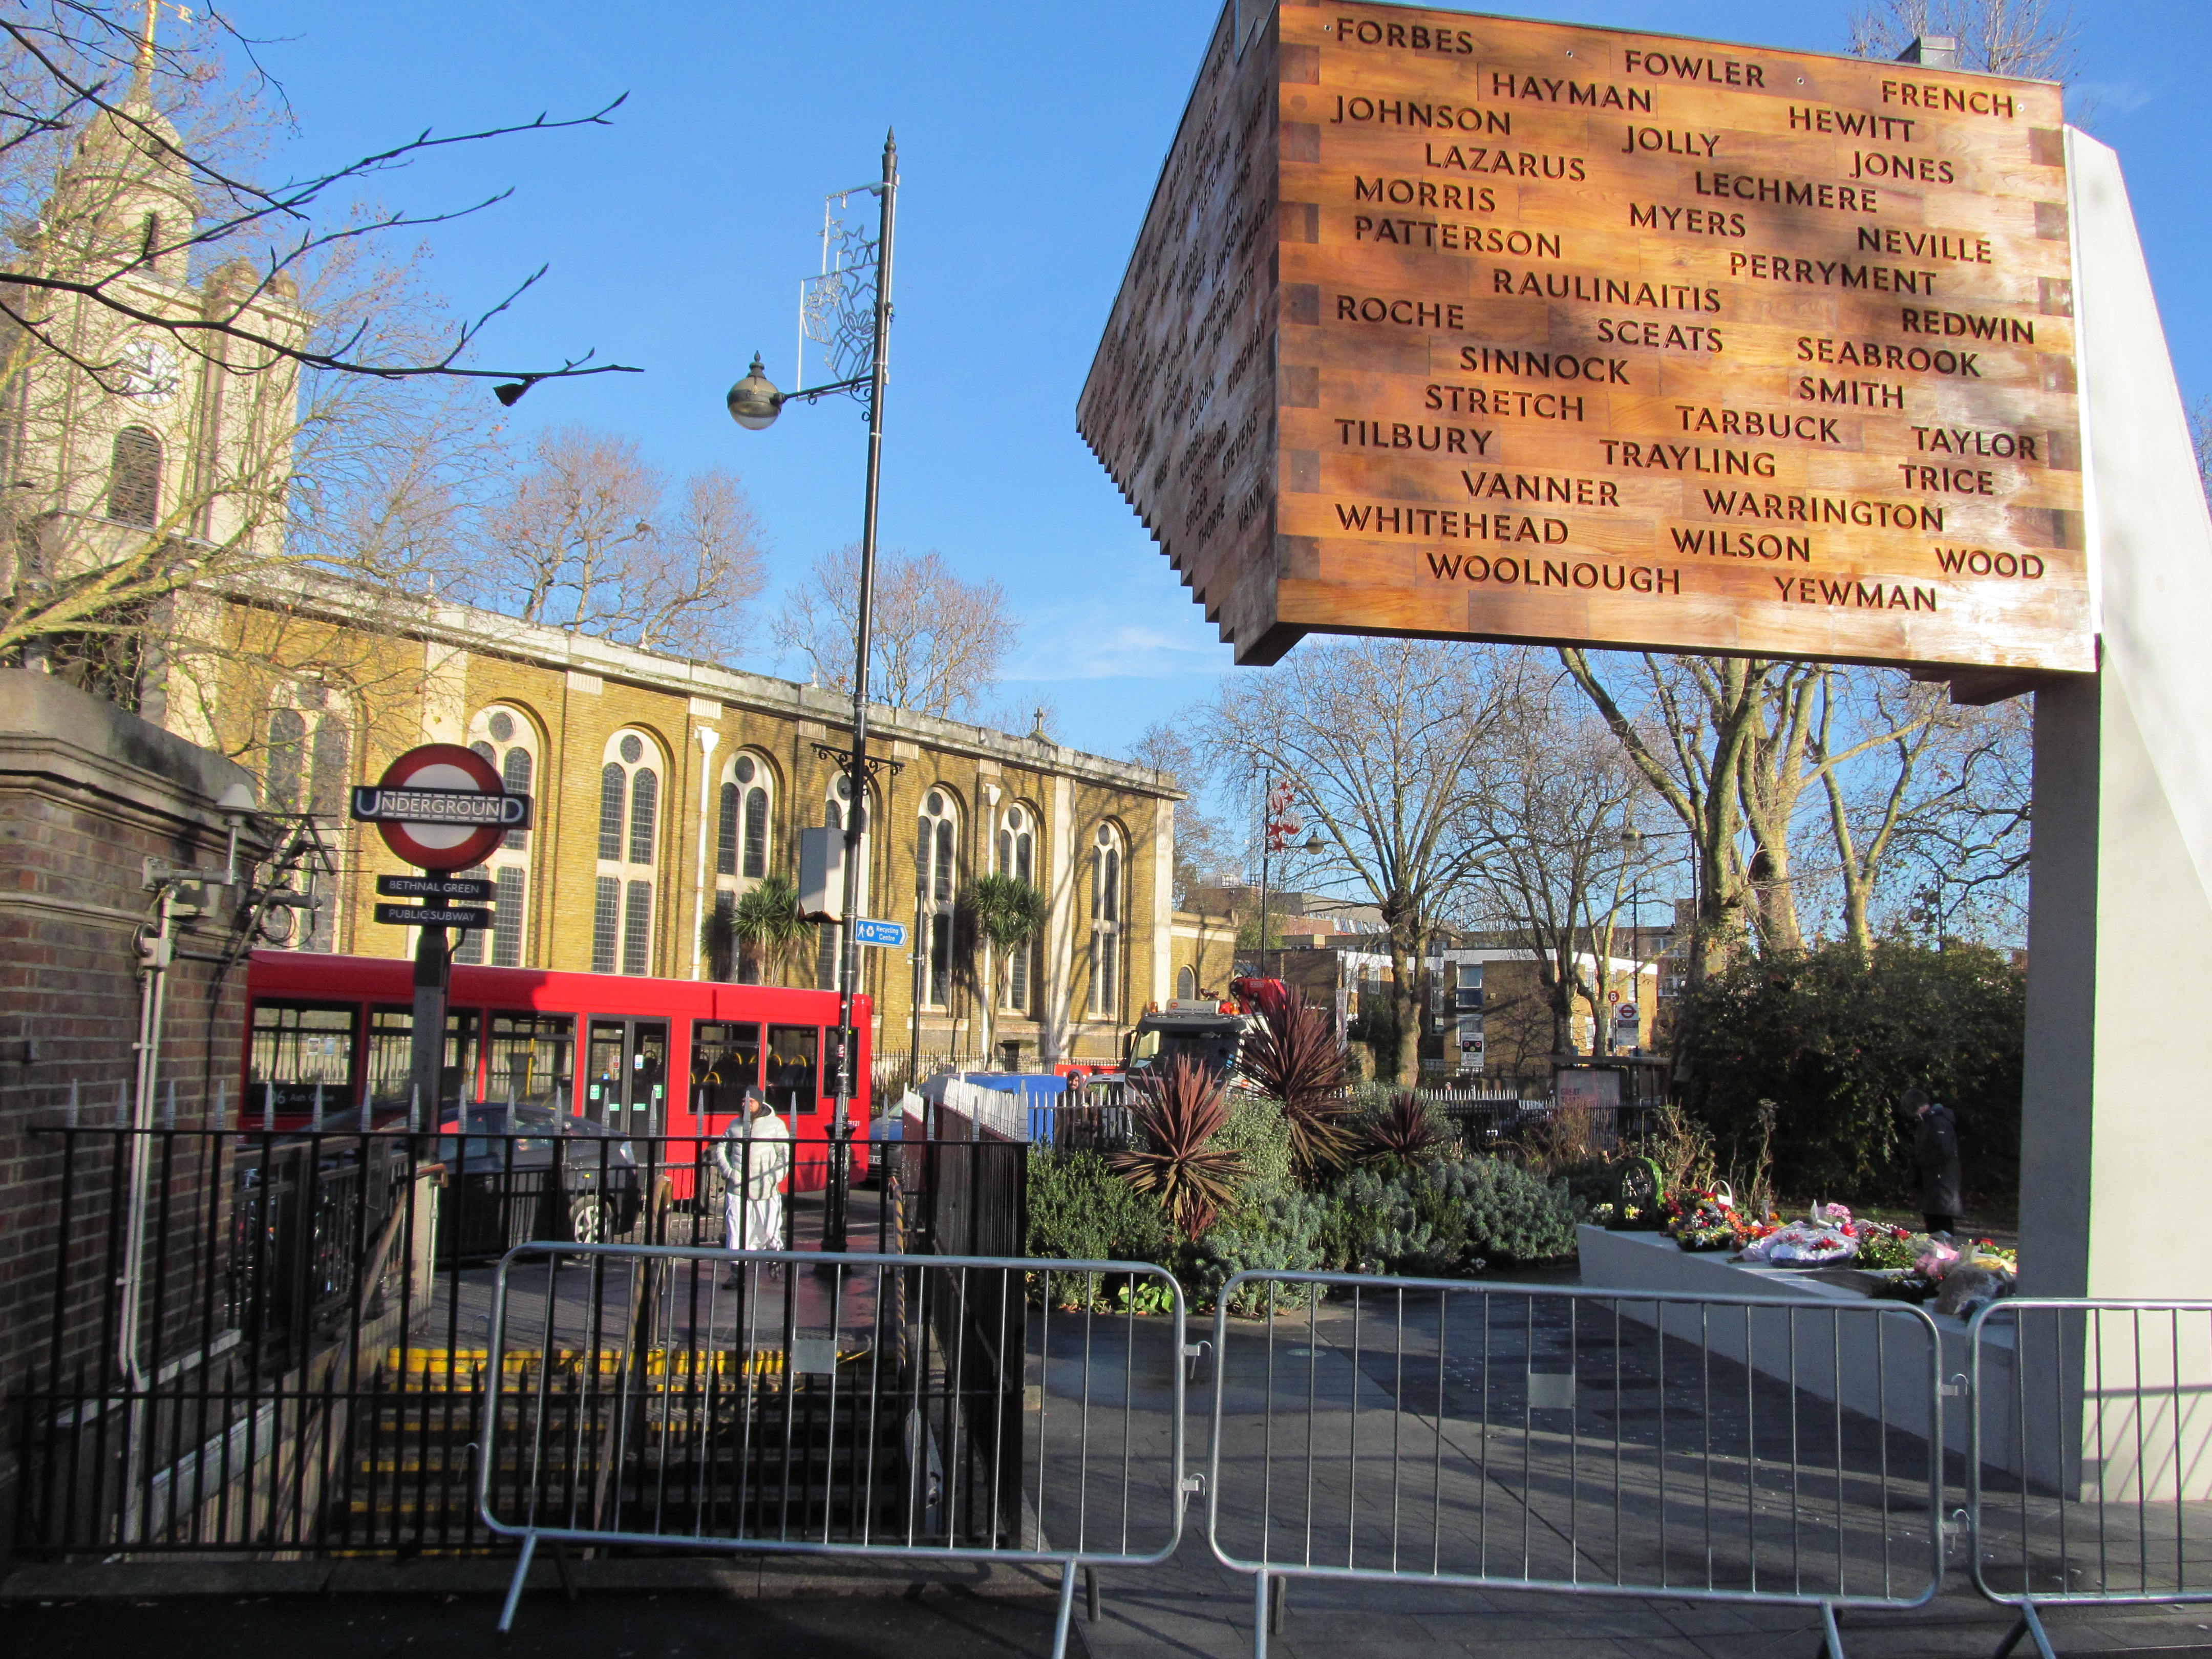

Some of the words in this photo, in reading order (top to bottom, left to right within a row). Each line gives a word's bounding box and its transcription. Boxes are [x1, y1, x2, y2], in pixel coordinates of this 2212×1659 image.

[1337, 18, 1473, 55] FORBES
[1626, 50, 1765, 88] FOWLER
[1882, 80, 2014, 118] FRENCH
[1169, 143, 1187, 197] BAKER
[1213, 32, 1229, 85] BASS
[1331, 95, 1511, 136] JOHNSON
[1623, 125, 1720, 157] JOLLY
[1850, 151, 1954, 184] JONES
[1493, 73, 1651, 113] HAYMAN
[1790, 107, 1915, 142] HEWITT
[1152, 204, 1175, 270] BOWLING
[1196, 97, 1217, 159] BOXER
[1175, 136, 1216, 238] CLATWORTHY
[1176, 239, 1198, 299] HARRIS
[1235, 80, 1267, 165] HAWLEY
[1426, 143, 1585, 181] LAZARUS
[1696, 172, 1877, 213] LECHMERE
[1161, 251, 1179, 304] EMERY
[1197, 132, 1230, 218] FLETCHER
[1354, 176, 1496, 211] MORRIS
[1630, 203, 1746, 238] MYERS
[1858, 226, 1992, 264] NEVILLE
[1355, 216, 1560, 259] PATTERSON
[1731, 252, 1937, 295] PERRYMENT
[1136, 336, 1168, 415] HUTCHINSON
[1188, 252, 1205, 306] INGLE
[1225, 155, 1250, 224] JOHNS
[1161, 369, 1181, 422] MASON
[1194, 281, 1224, 355] MATHERS
[1241, 195, 1266, 263] MEAD
[1164, 326, 1187, 386] LAPHAM
[1212, 207, 1242, 286] LAWSON
[1494, 269, 1721, 313] RAULINAITIS
[1903, 308, 2034, 344] REDWIN
[1173, 377, 1193, 429] NIXON
[1213, 259, 1253, 351] PAPWORTH
[1337, 295, 1464, 330] ROCHE
[1598, 318, 1724, 353] SCEATS
[1798, 337, 1980, 377] SEABROOK
[1180, 421, 1204, 481] RIDDELL
[1228, 310, 1266, 395] RIDGWAY
[1189, 369, 1214, 430] QUORN
[1460, 347, 1630, 385] SINNOCK
[1800, 376, 1904, 409] SMITH
[1191, 416, 1226, 492] SHEPHERD
[1334, 419, 1493, 455] TILBURY
[1600, 439, 1776, 477] TRAYLING
[1899, 464, 1993, 496] TRICE
[1425, 385, 1583, 421] STRETCH
[1675, 406, 1841, 443] TARBUCK
[1911, 427, 2037, 460] TAYLOR
[1186, 483, 1207, 536] SPICER
[1223, 404, 1257, 477] STEVENS
[1238, 478, 1262, 533] VANN
[1461, 470, 1620, 507] VANNER
[1704, 490, 1944, 531] WARRINGTON
[1198, 492, 1225, 551] THORPE
[1335, 503, 1568, 545] WHITEHEAD
[1671, 527, 1811, 562] WILSON
[1934, 548, 2044, 580] WOOD
[1427, 552, 1680, 595] WOOLNOUGH
[1774, 576, 1937, 612] YEWMAN
[356, 790, 524, 822] UNDERGROUND
[389, 909, 429, 919] PUBLIC
[430, 910, 475, 922] SUBWAY
[390, 880, 439, 892] BETHNAL
[443, 882, 479, 894] GREEN
[876, 925, 899, 935] Recycling
[879, 933, 895, 942] Centre
